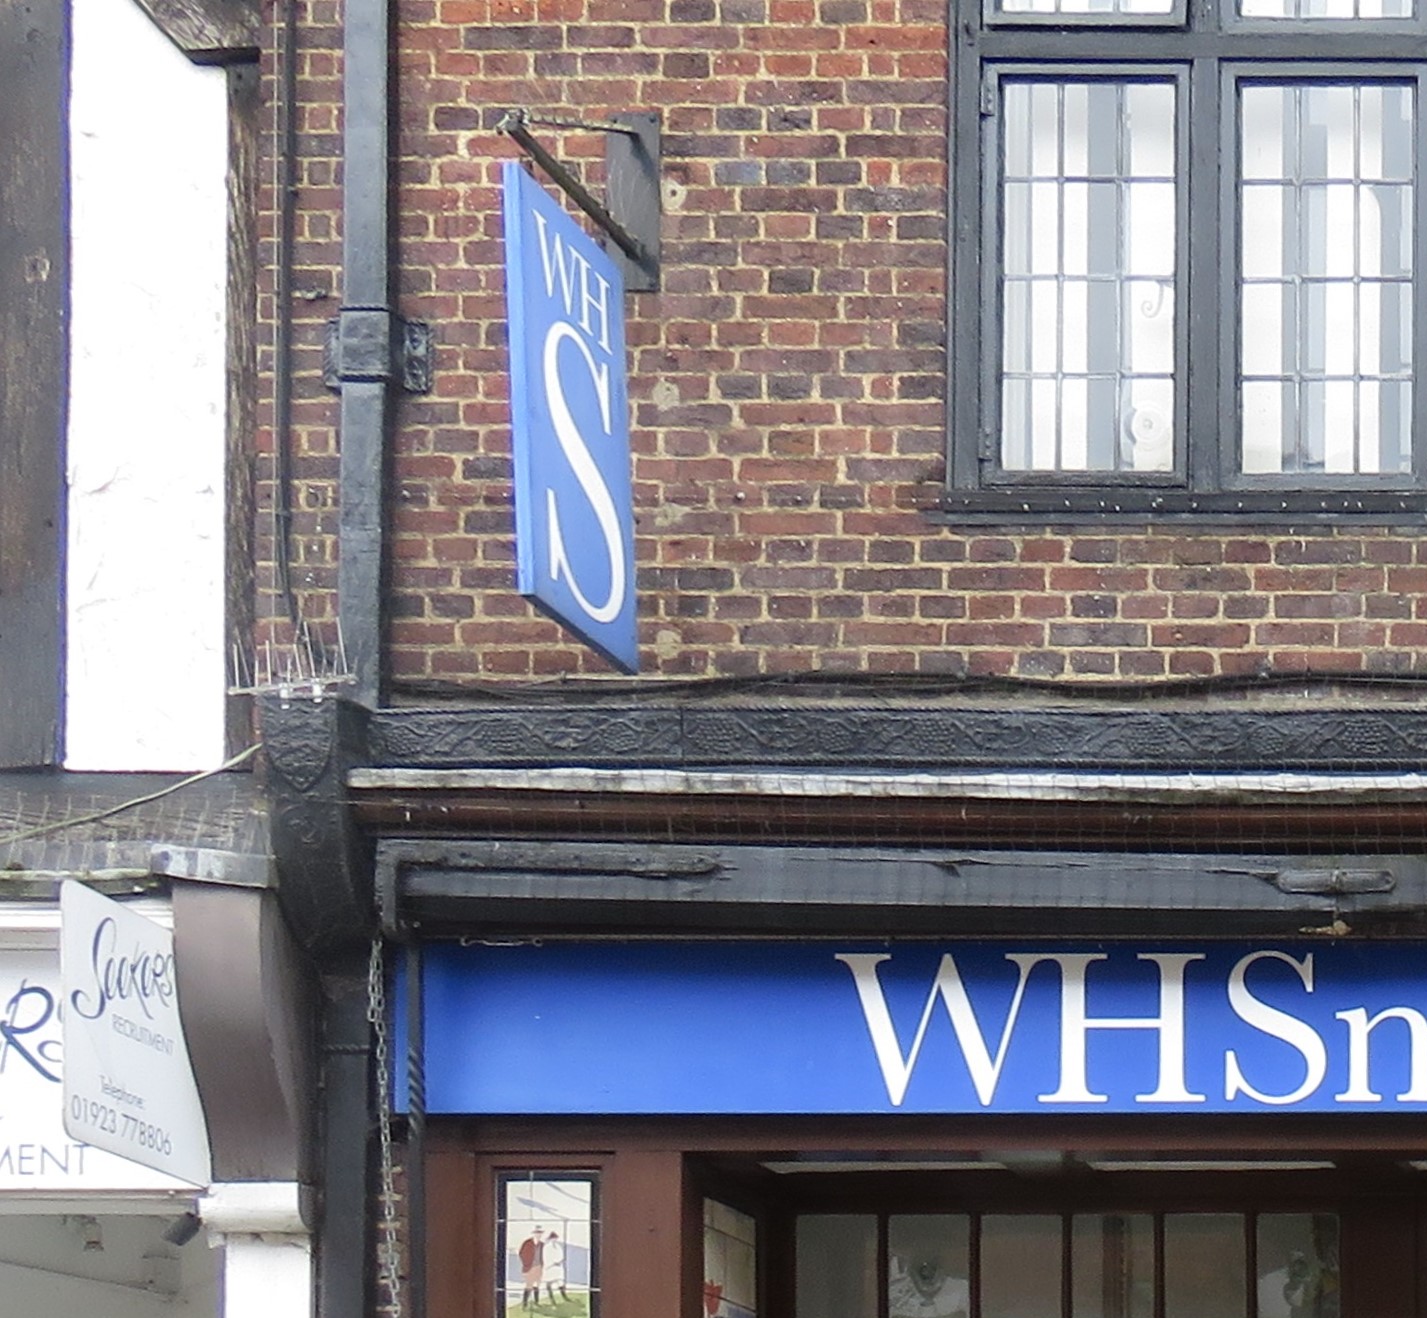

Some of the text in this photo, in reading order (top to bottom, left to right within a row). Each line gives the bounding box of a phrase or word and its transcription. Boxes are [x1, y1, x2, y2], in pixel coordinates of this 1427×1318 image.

[112, 1013, 175, 1056] RECRUITMENT
[71, 1094, 172, 1156] 01923 778806
